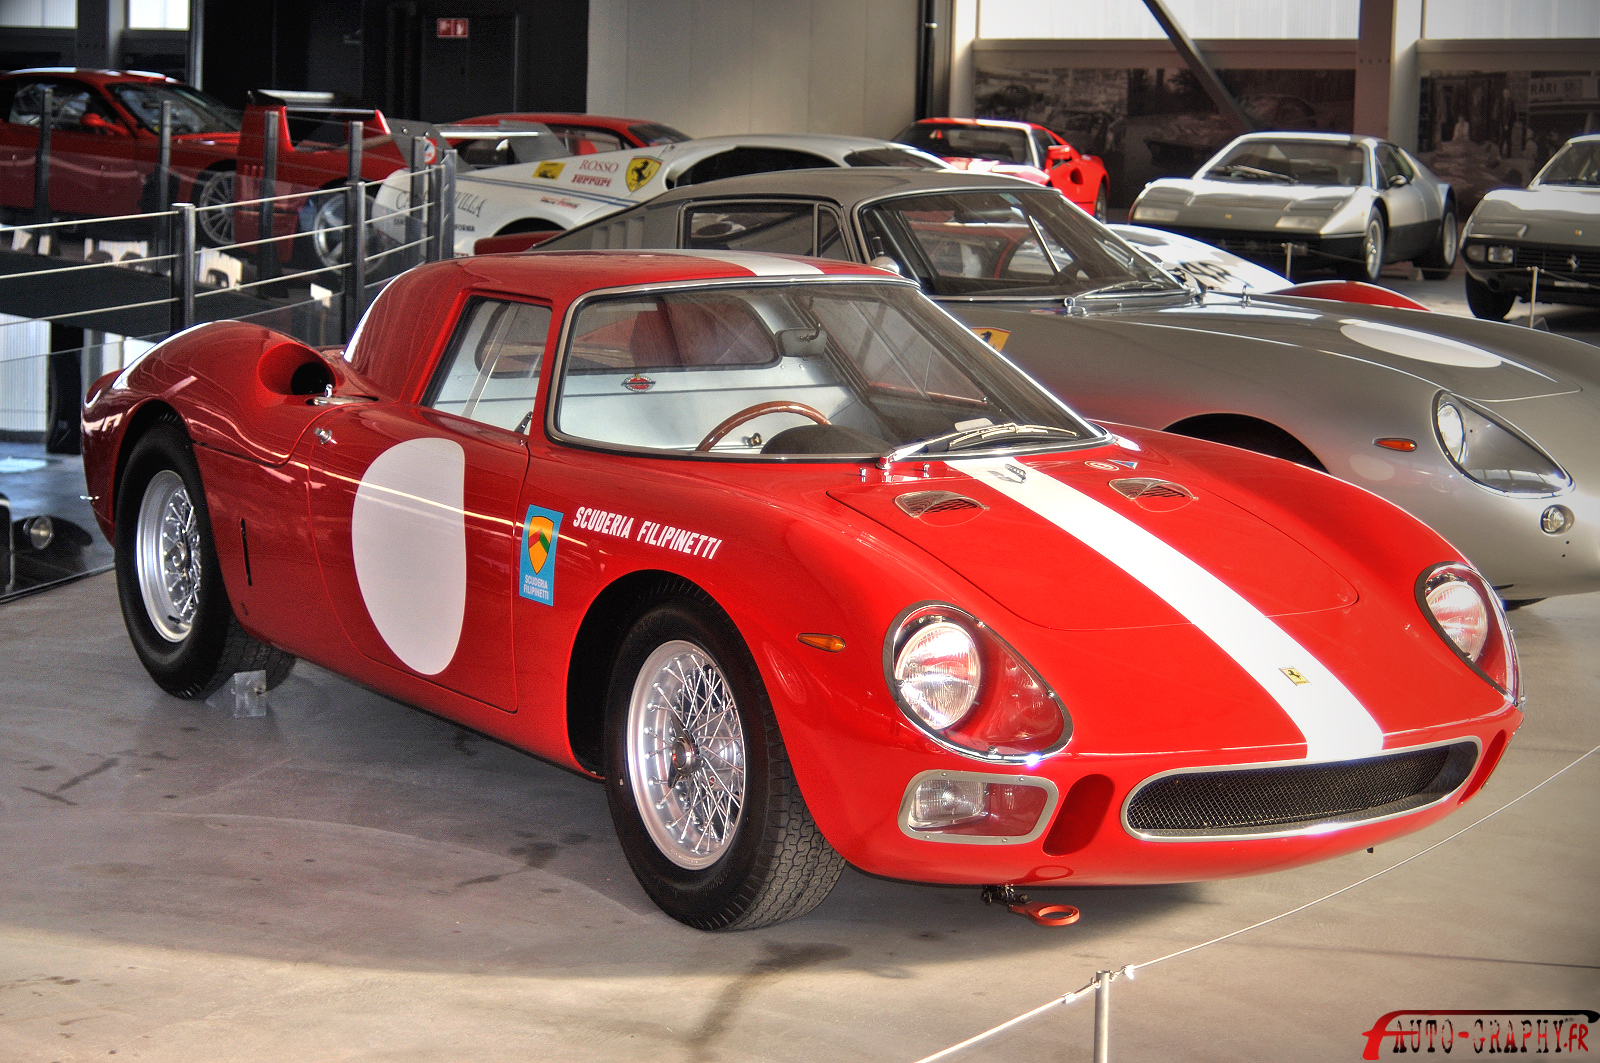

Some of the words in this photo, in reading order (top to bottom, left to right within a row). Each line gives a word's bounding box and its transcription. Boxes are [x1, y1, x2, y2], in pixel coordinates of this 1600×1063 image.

[579, 159, 619, 173] ROSSO
[571, 173, 612, 187] Ferrari
[572, 506, 635, 539] SCUDERIA
[636, 520, 723, 560] FILIPINETTI
[524, 574, 548, 590] SCUDERIA
[523, 583, 549, 600] FILIPINETTI
